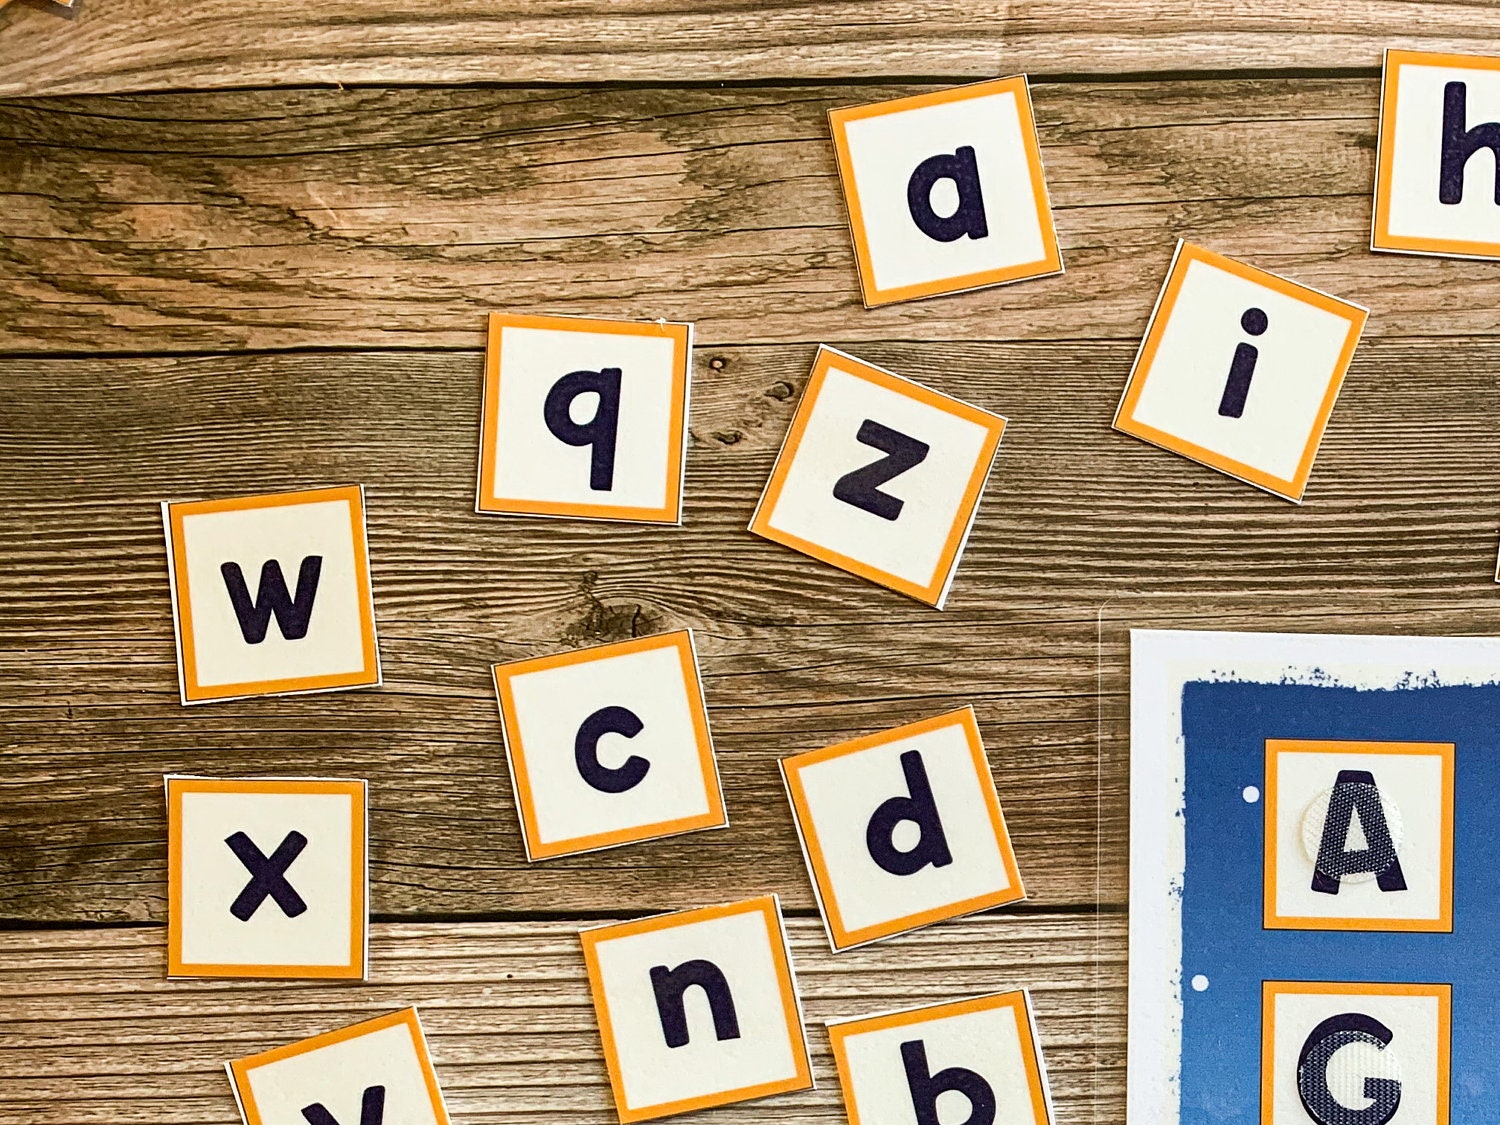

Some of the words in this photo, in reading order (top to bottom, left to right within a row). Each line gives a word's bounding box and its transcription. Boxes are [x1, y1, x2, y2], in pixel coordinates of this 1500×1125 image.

[907, 146, 988, 242] a
[1218, 308, 1268, 418] i
[544, 368, 622, 491] q
[833, 419, 929, 521] z
[221, 556, 322, 644] w
[575, 706, 650, 793] c
[866, 750, 953, 876] d
[1311, 770, 1408, 895] A
[224, 831, 307, 921] x
